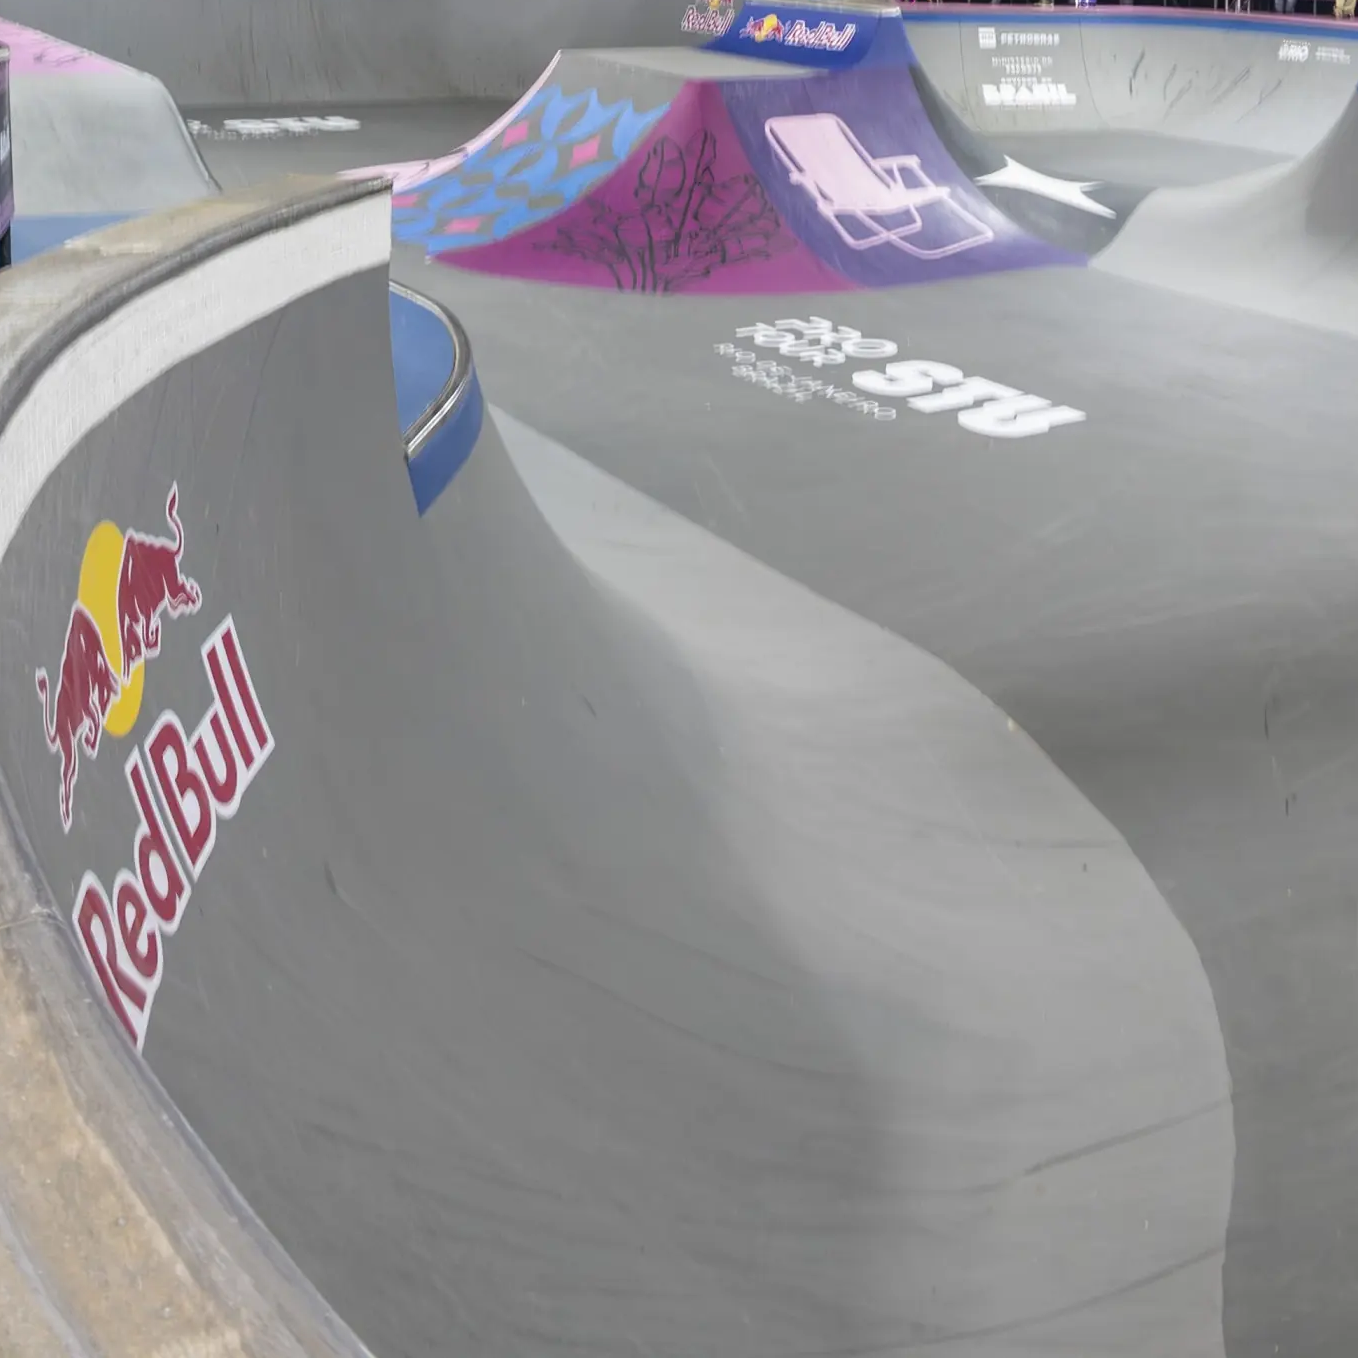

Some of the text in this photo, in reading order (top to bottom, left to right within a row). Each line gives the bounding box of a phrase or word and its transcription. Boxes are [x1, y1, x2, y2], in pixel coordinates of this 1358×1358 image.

[852, 360, 1087, 438] STU
[73, 614, 275, 1053] Red Bull
